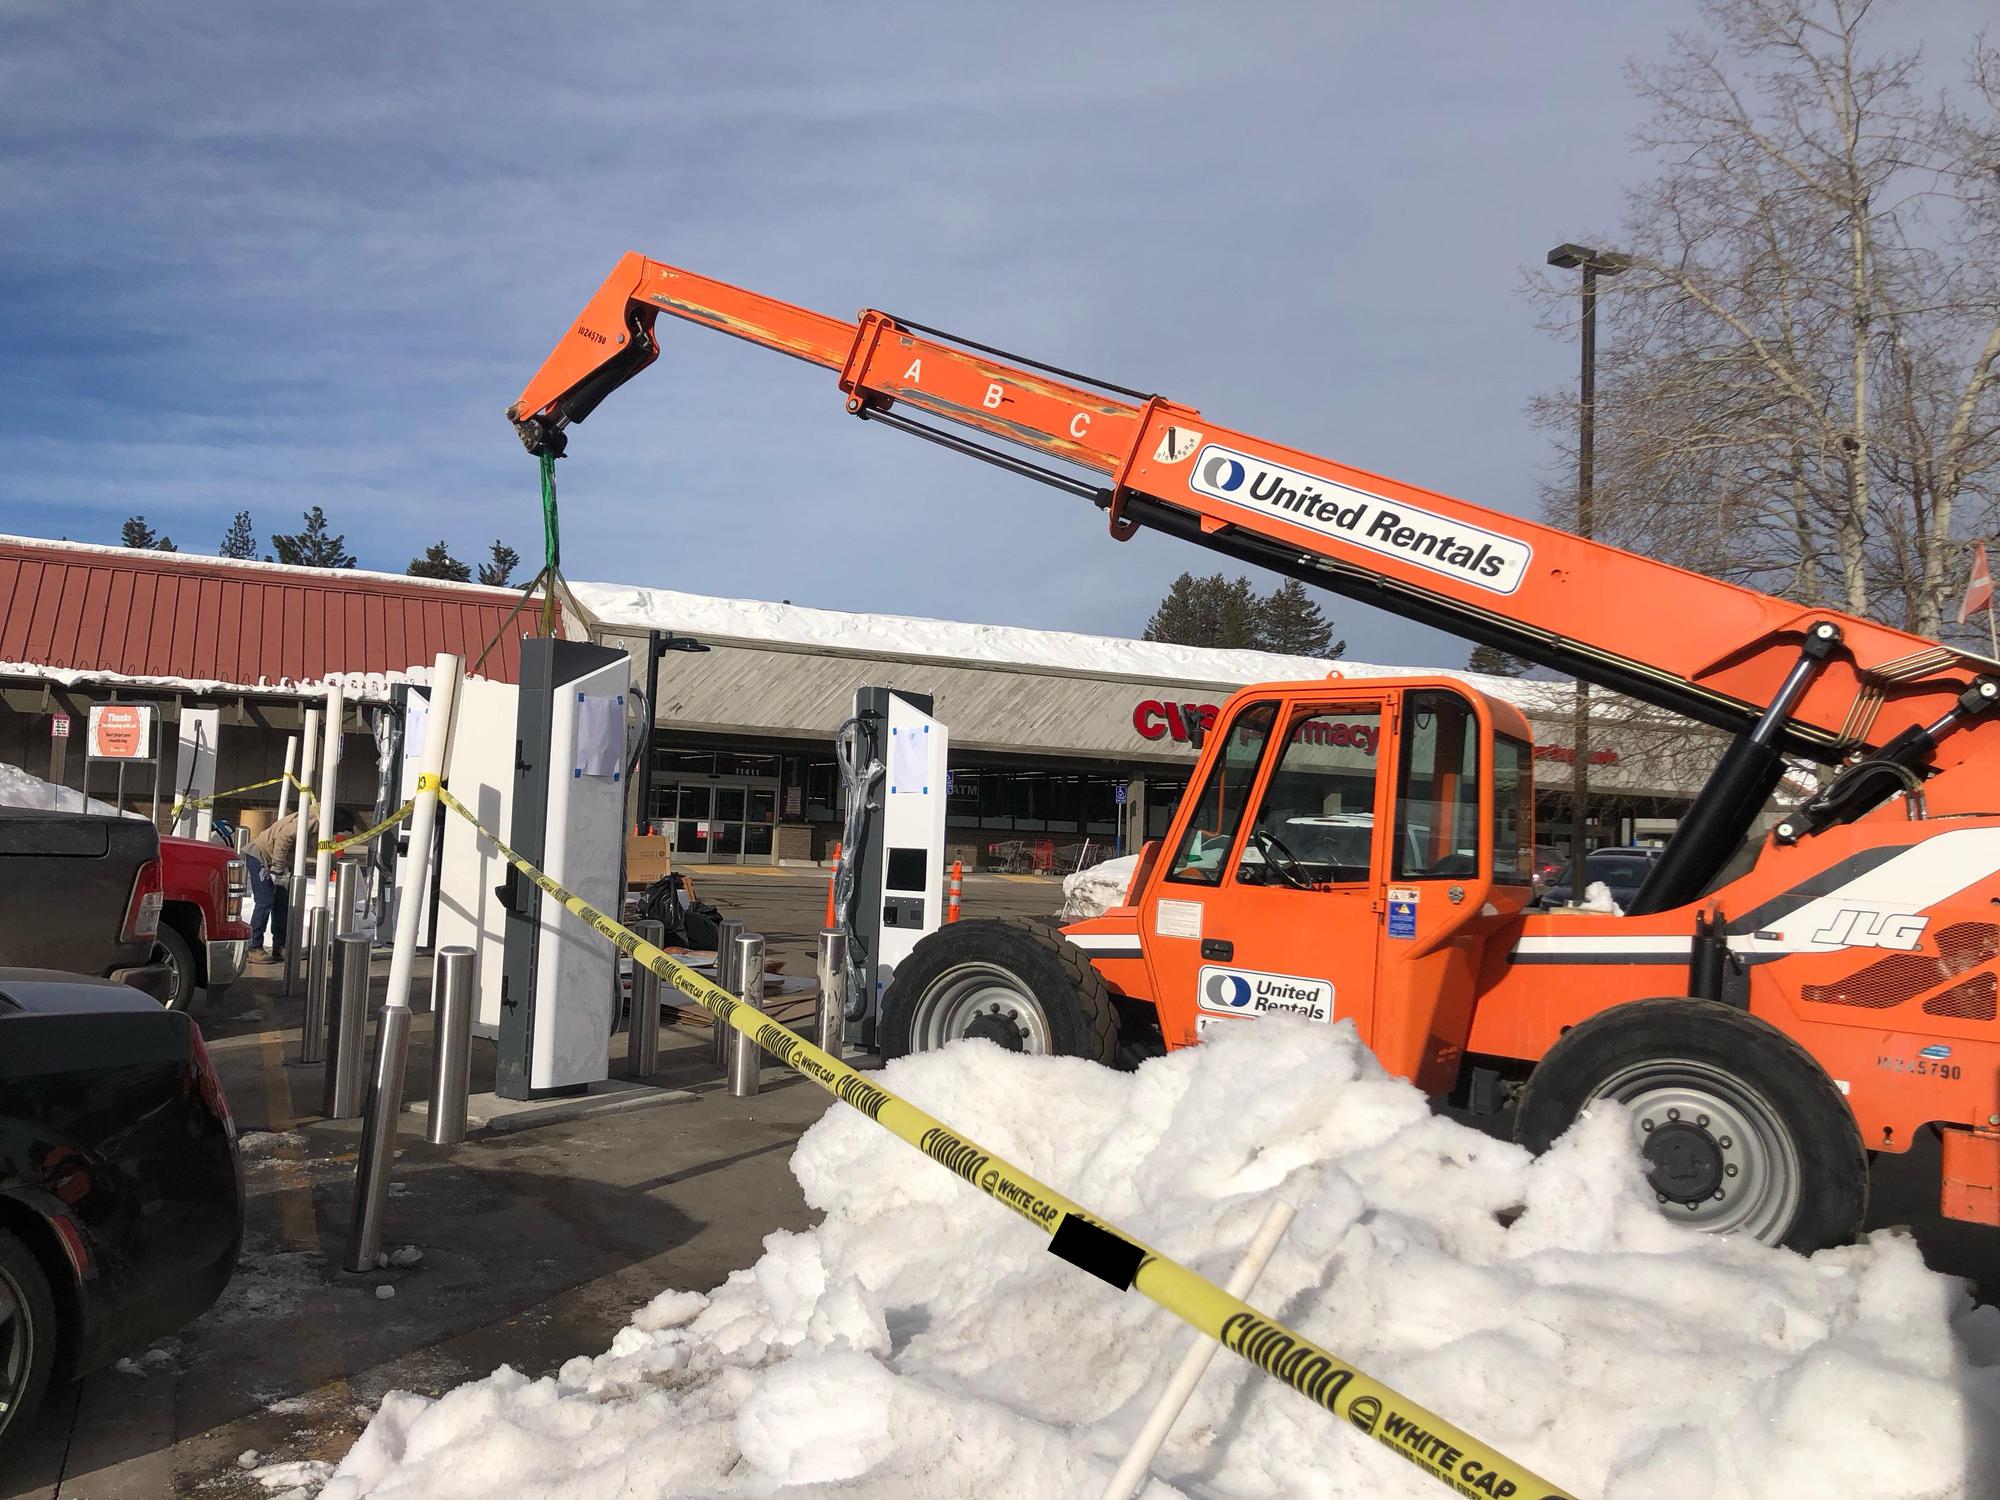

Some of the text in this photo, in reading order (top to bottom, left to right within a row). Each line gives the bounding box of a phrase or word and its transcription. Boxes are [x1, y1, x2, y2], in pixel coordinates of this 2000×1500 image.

[577, 326, 607, 345] 10245790
[904, 358, 1091, 438] A B C
[1249, 471, 1506, 577] United Rentals
[107, 713, 132, 721] Thanks
[736, 768, 760, 776] 11411
[953, 784, 977, 796] ATM
[1811, 909, 1931, 951] JLG
[680, 978, 704, 999] WHITE CAP
[1256, 980, 1320, 1002] United
[801, 1055, 835, 1085] WHITE CAP
[997, 1177, 1036, 1208] WHITE
[1031, 1199, 1059, 1222] CAP
[1383, 1411, 1518, 1500] WHITE CAP
